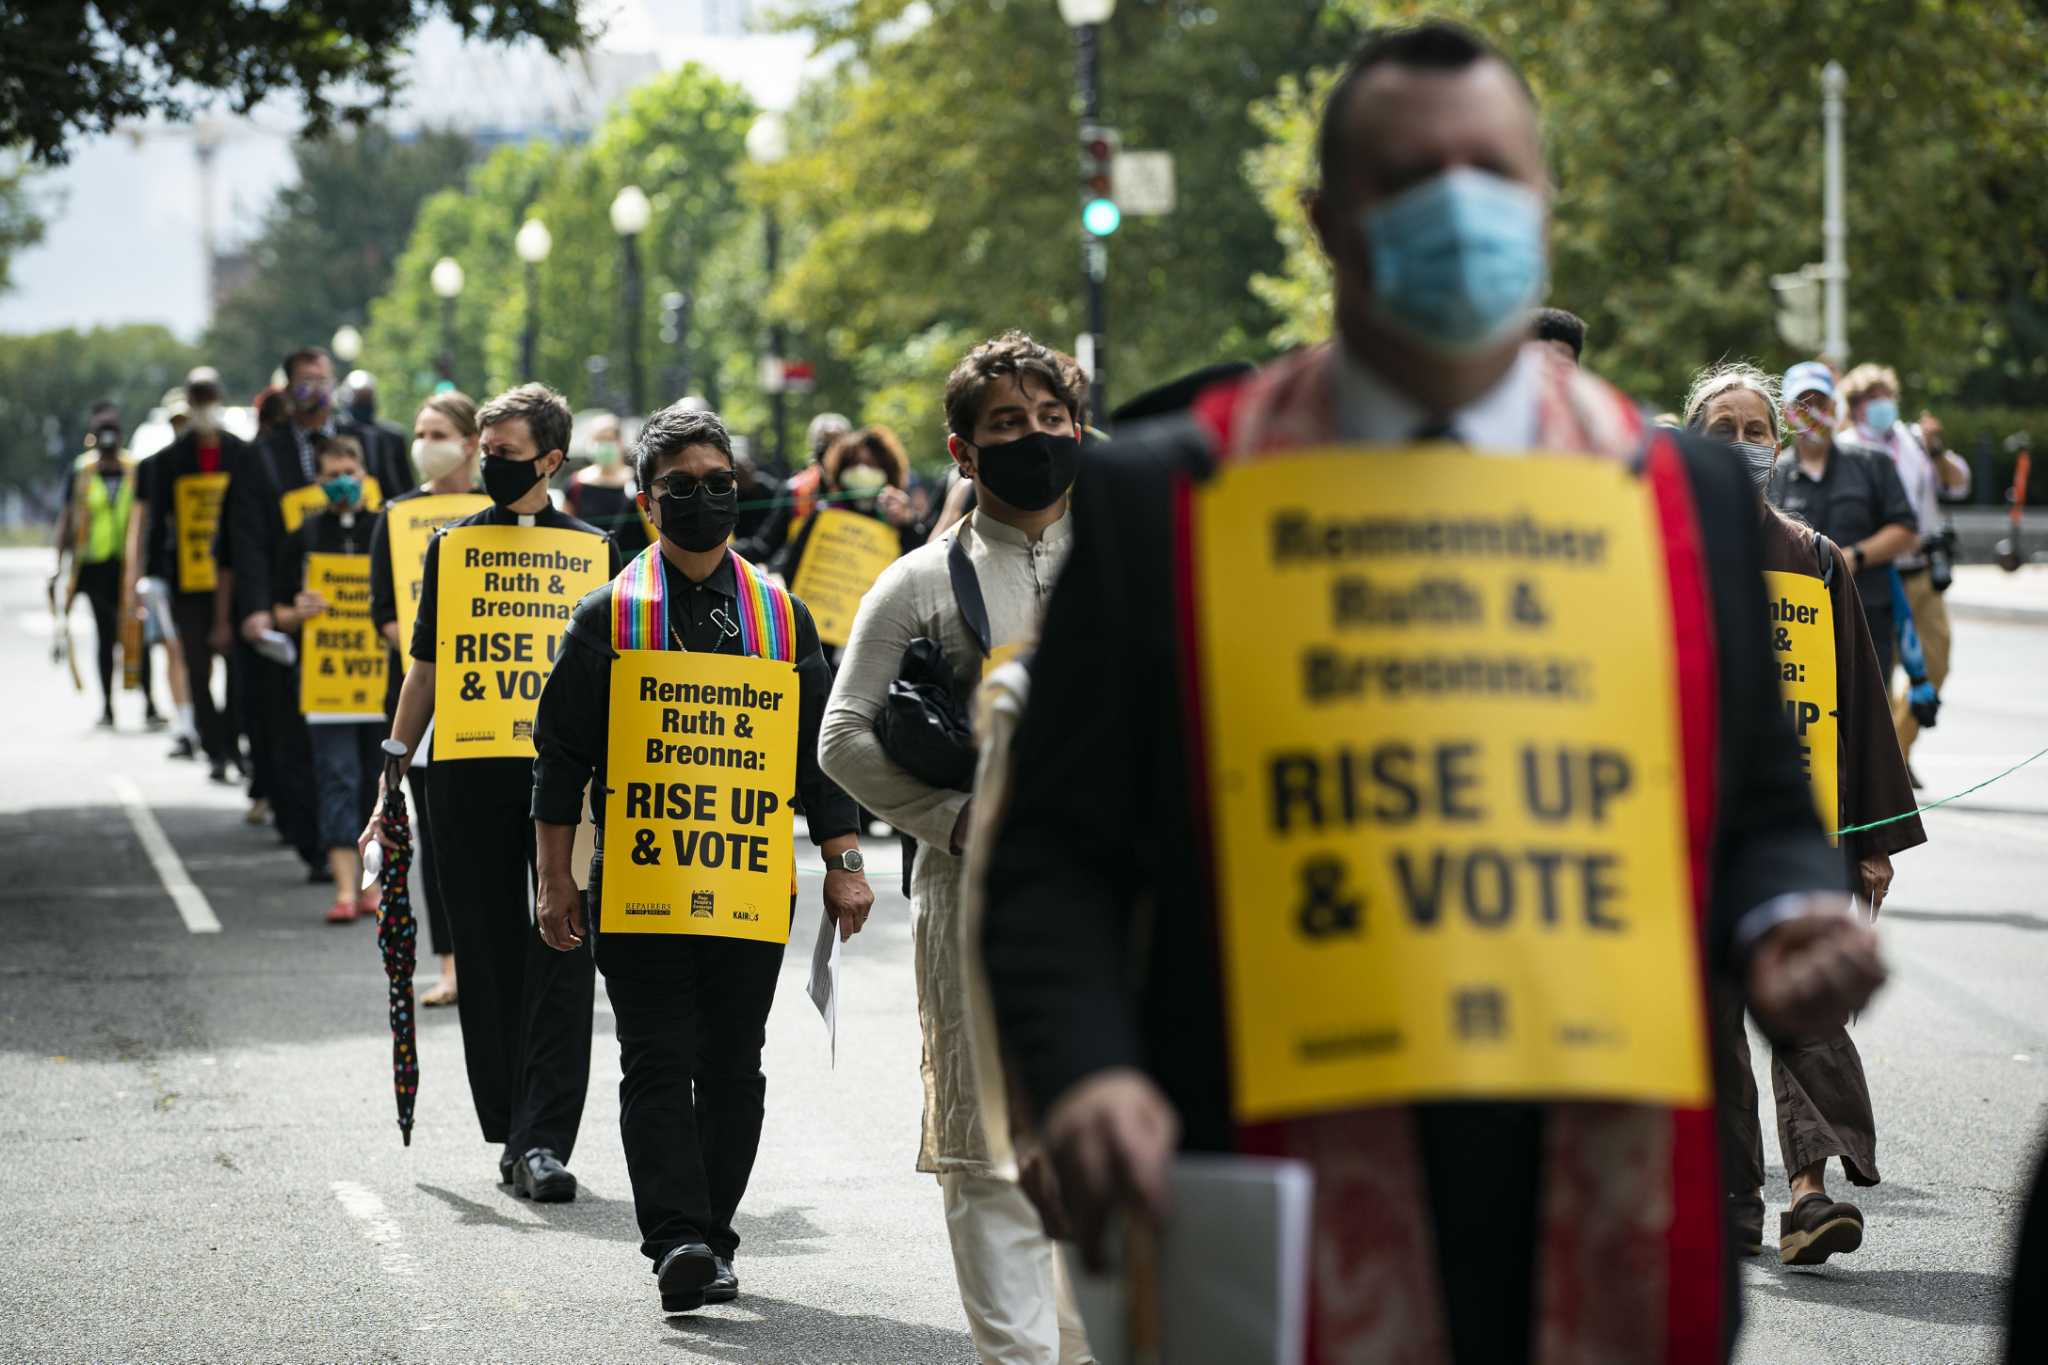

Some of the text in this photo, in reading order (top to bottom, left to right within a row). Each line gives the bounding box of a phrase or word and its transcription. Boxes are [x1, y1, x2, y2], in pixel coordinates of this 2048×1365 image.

[465, 548, 592, 574] Remember
[485, 573, 565, 594] Ruth &
[455, 633, 533, 664] RISE
[1775, 627, 1792, 652] &
[460, 671, 486, 702] &
[640, 676, 783, 711] Remember
[662, 708, 753, 738] Ruth &
[646, 739, 765, 770] Breonna:
[626, 782, 778, 826] RISE UP
[1268, 742, 1633, 836] RISE UP
[631, 829, 768, 873] & VOTE
[1294, 848, 1628, 939] & VOTE
